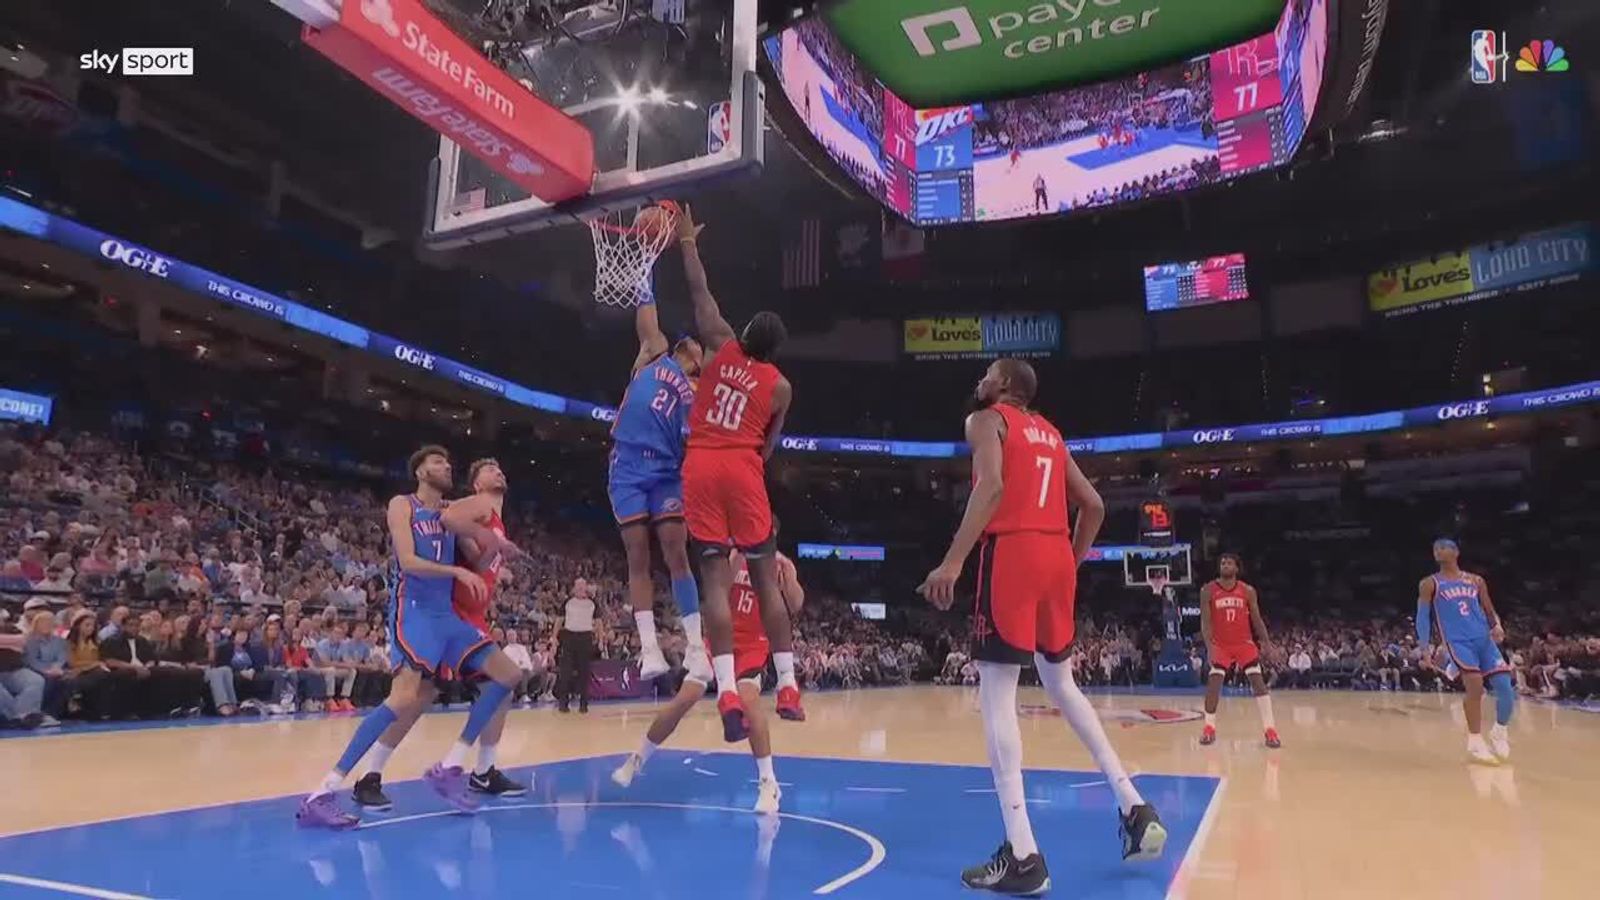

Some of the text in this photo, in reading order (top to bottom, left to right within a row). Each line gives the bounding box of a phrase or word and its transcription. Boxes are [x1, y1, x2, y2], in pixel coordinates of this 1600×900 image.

[1004, 7, 1160, 58] center
[1234, 82, 1258, 112] 77
[934, 144, 955, 169] 73
[719, 364, 760, 391] CAPELA
[651, 387, 678, 418] 21
[705, 382, 748, 431] 30
[1036, 455, 1053, 508] 7
[432, 540, 441, 561] 7
[738, 589, 755, 614] 15
[1226, 608, 1236, 621] 17
[1458, 600, 1470, 616] 2
